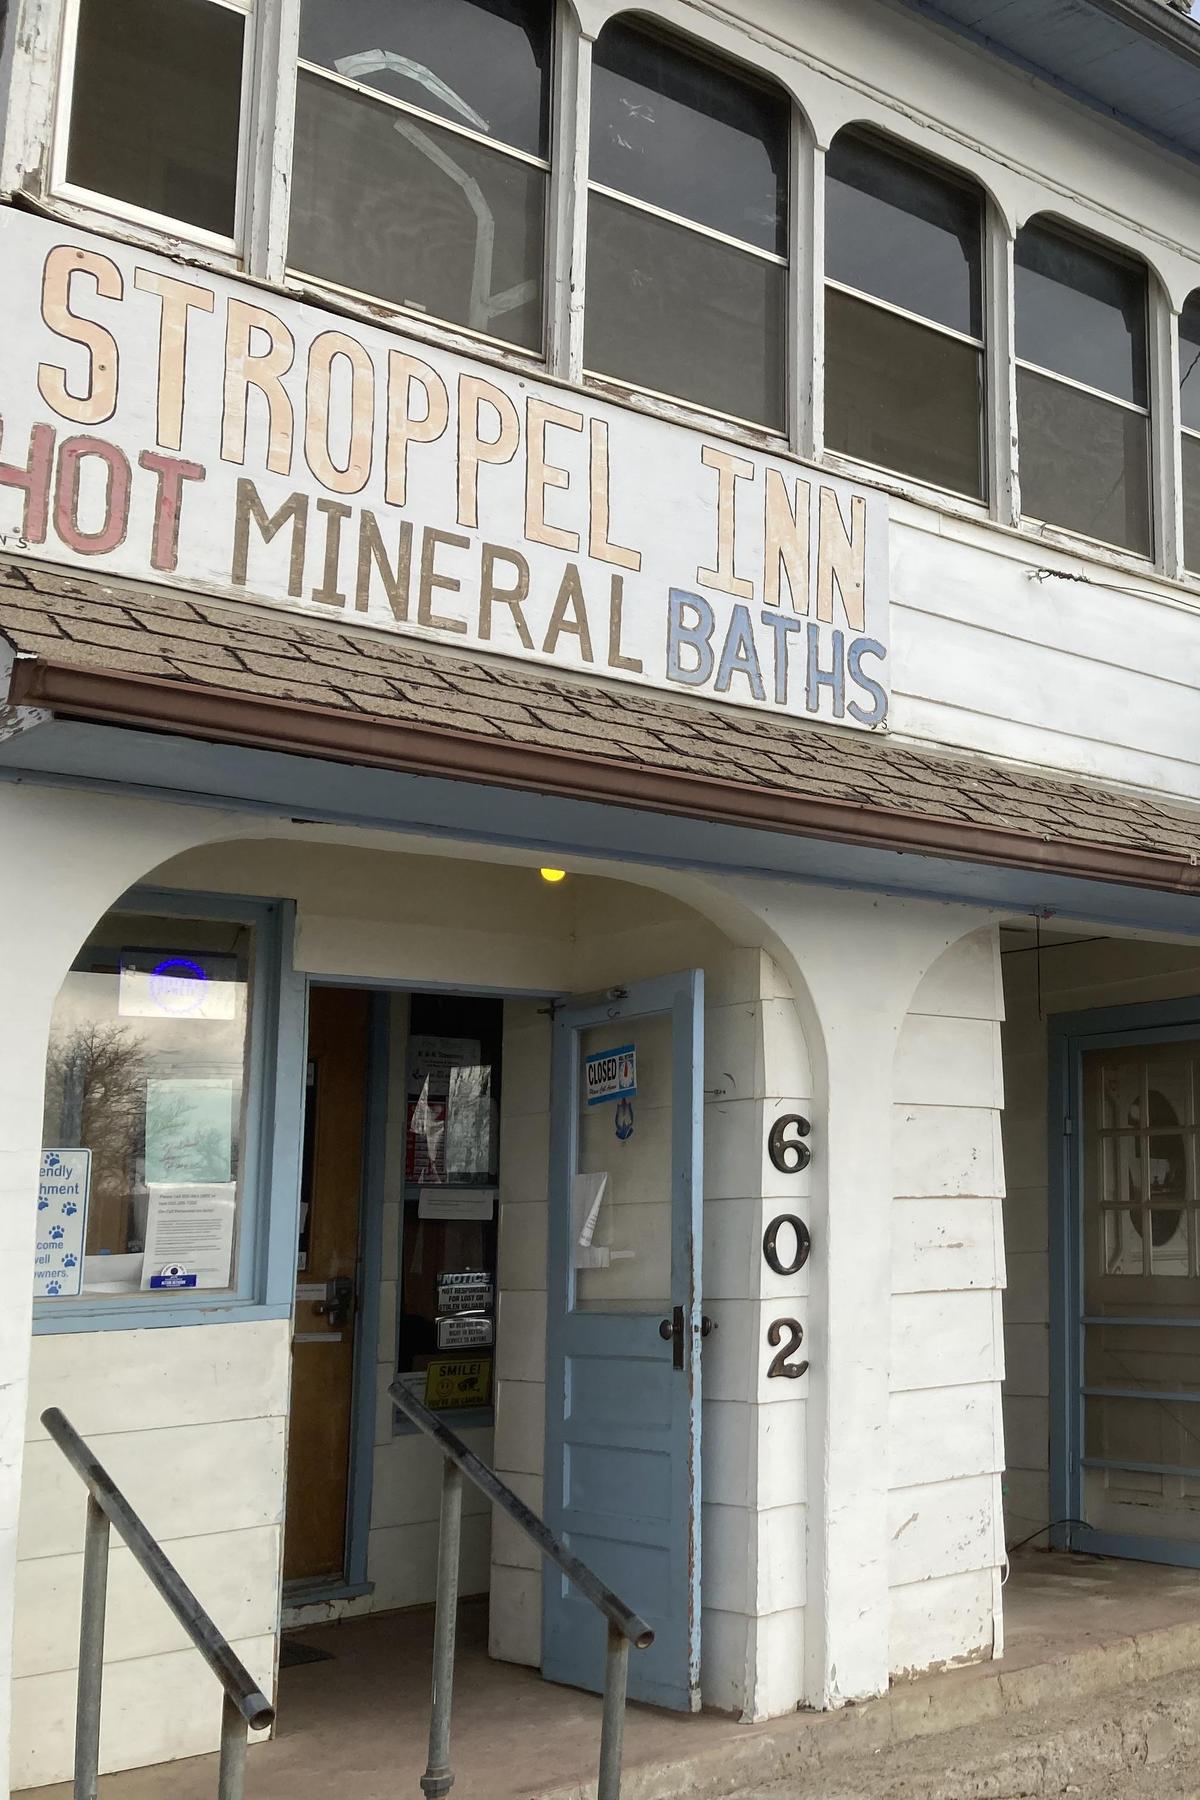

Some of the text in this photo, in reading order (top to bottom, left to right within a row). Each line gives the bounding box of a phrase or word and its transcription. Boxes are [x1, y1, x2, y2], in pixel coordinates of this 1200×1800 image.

[37, 245, 866, 630] STROPPEL INN
[0, 421, 888, 725] HOT MINERAL BATHS
[588, 1058, 617, 1086] CLOSED
[441, 1272, 491, 1284] NOTICE
[441, 1287, 453, 1295] NOT
[448, 1295, 460, 1303] FOR
[461, 1294, 475, 1302] LOST
[439, 1364, 480, 1377] SMILE!
